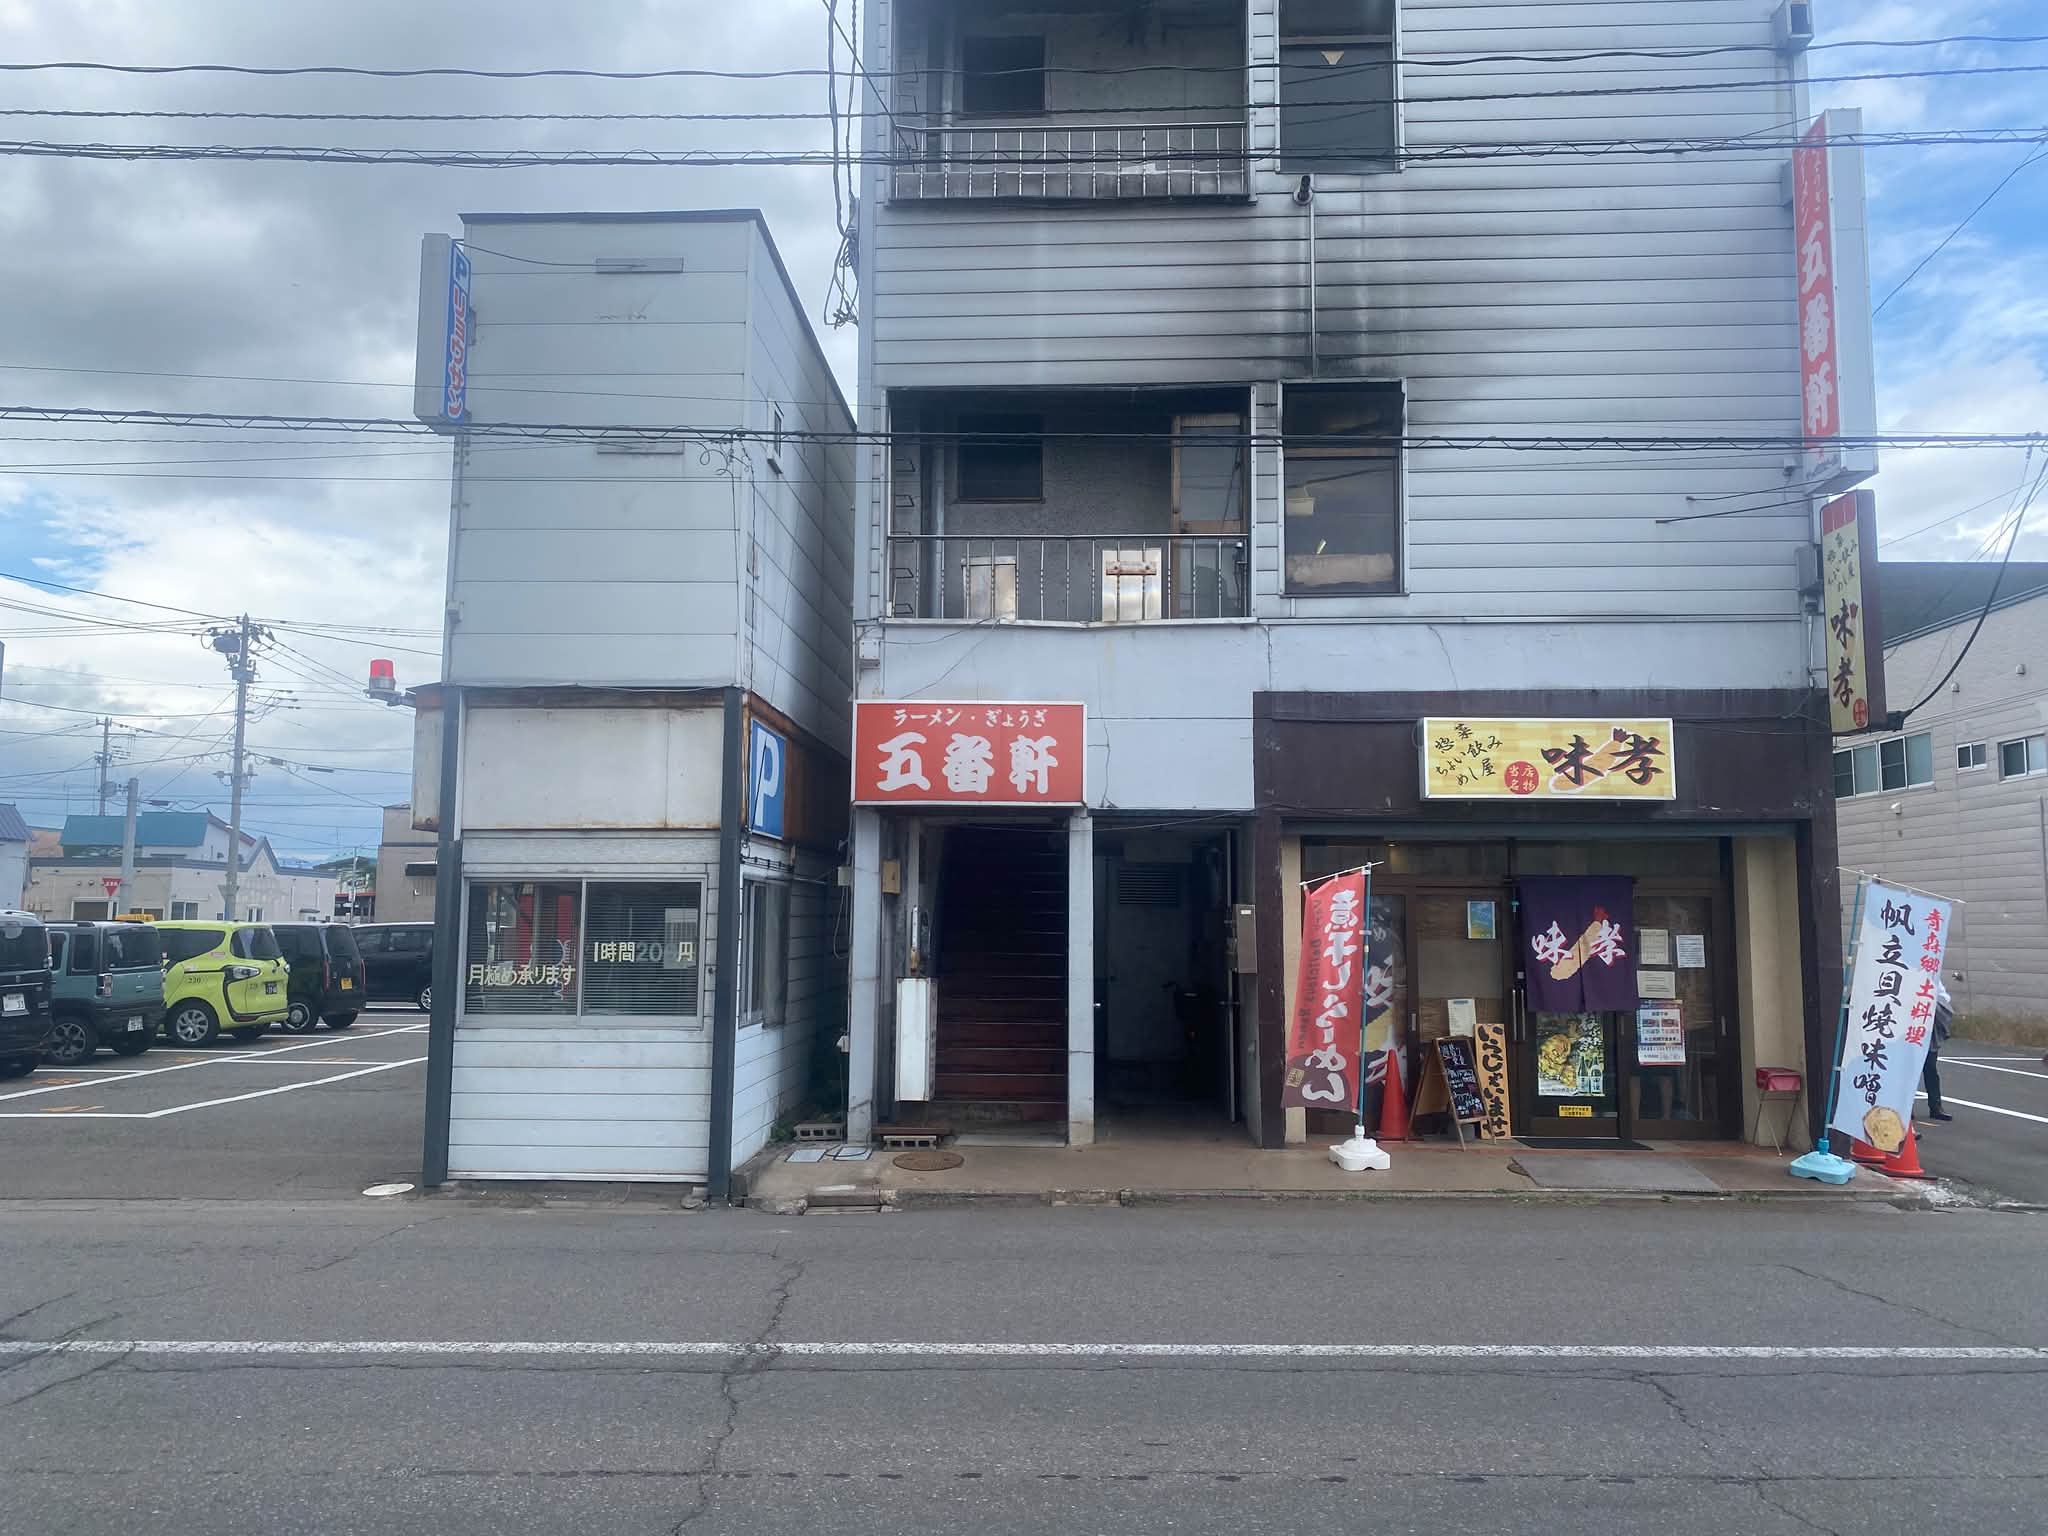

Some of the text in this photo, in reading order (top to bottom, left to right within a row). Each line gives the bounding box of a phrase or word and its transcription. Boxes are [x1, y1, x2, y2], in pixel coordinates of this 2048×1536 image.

[1800, 220, 1832, 434] 五番軒
[1830, 598, 1855, 709] 味孝
[754, 727, 780, 827] P
[877, 731, 1059, 794] 五番軒
[1454, 757, 1497, 787] めし屋
[1540, 733, 1666, 787] 味孝
[1531, 920, 1627, 966] 味孝
[468, 964, 577, 987] 月極め承ります
[1904, 907, 1945, 1048] 青森郷土料理
